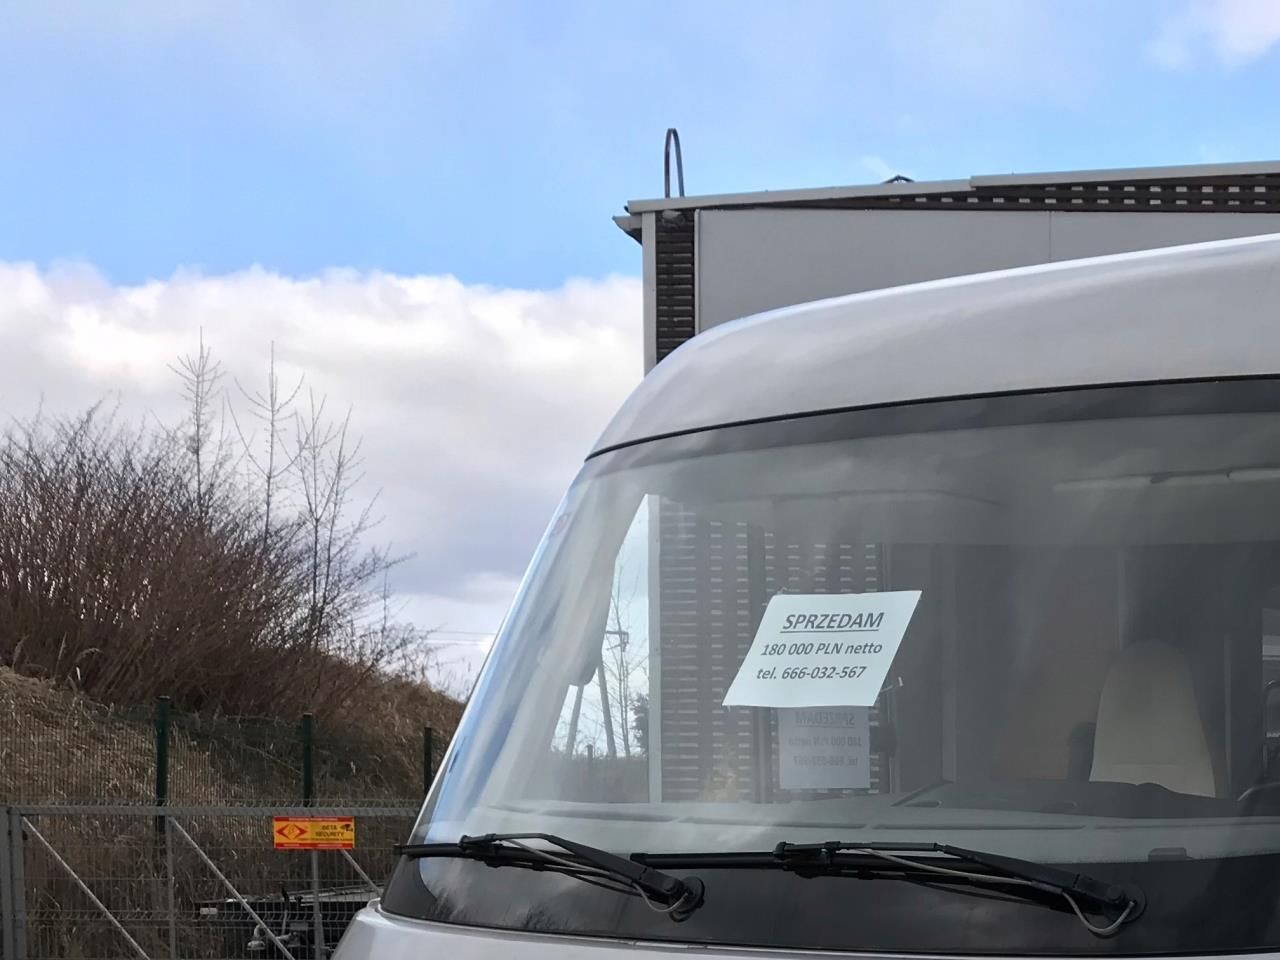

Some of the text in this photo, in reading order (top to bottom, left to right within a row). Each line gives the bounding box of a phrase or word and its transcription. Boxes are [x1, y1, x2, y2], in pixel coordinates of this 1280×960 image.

[782, 612, 885, 630] SPRZEDAM
[761, 642, 883, 656] 180 000 PLN netto
[756, 666, 868, 680] tel. 666-032-567
